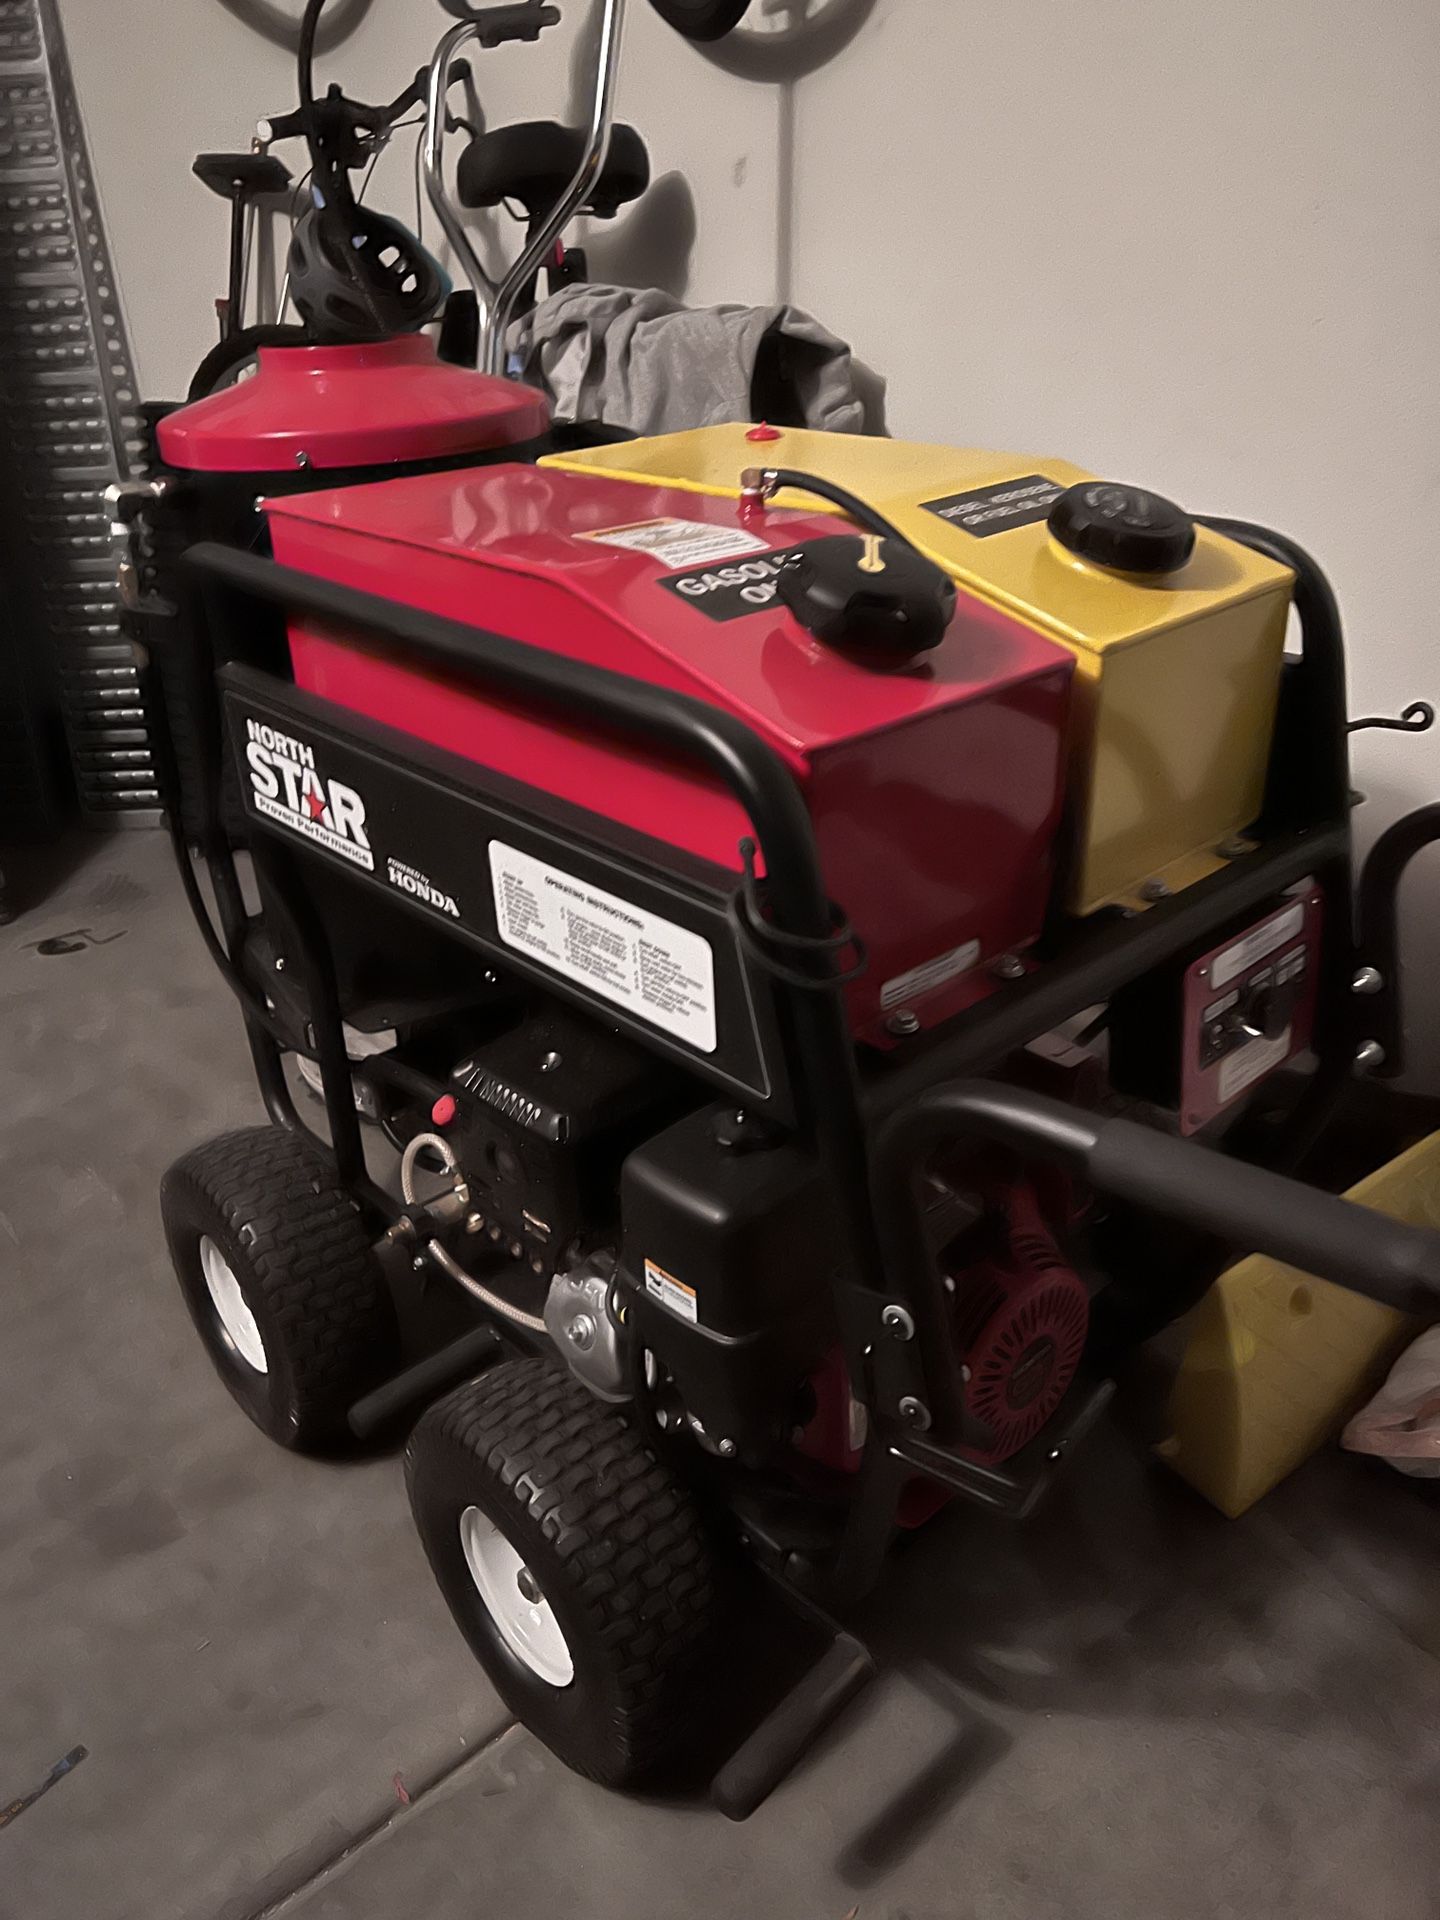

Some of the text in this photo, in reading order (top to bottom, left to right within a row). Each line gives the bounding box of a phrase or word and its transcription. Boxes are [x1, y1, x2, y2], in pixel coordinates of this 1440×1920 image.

[675, 554, 786, 595] GASOL
[246, 718, 315, 769] NORTH
[246, 741, 371, 850] STAR
[258, 797, 370, 864] Proven Performance
[387, 865, 461, 918] HONDA
